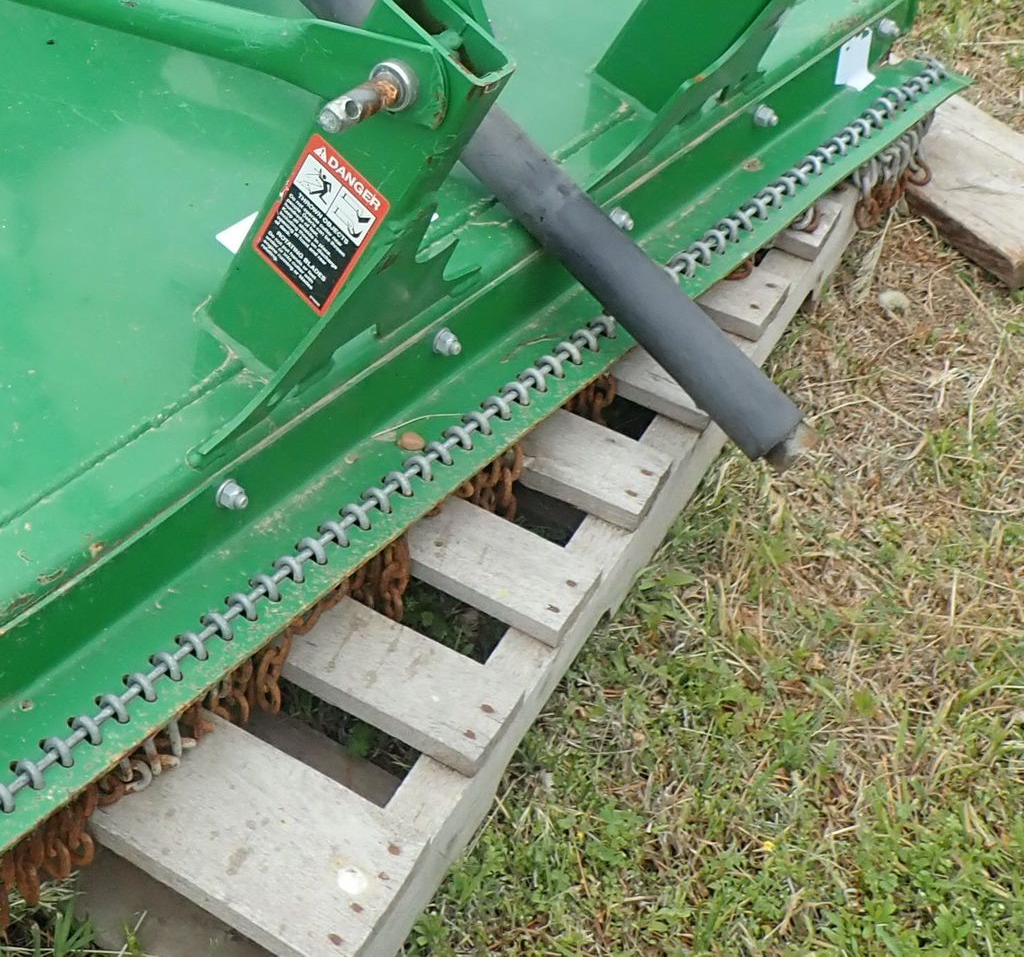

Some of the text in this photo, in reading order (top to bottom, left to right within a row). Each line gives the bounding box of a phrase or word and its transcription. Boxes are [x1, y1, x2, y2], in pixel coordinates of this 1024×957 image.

[326, 155, 382, 211] DANGER
[297, 192, 349, 246] THROWN OBJECTS
